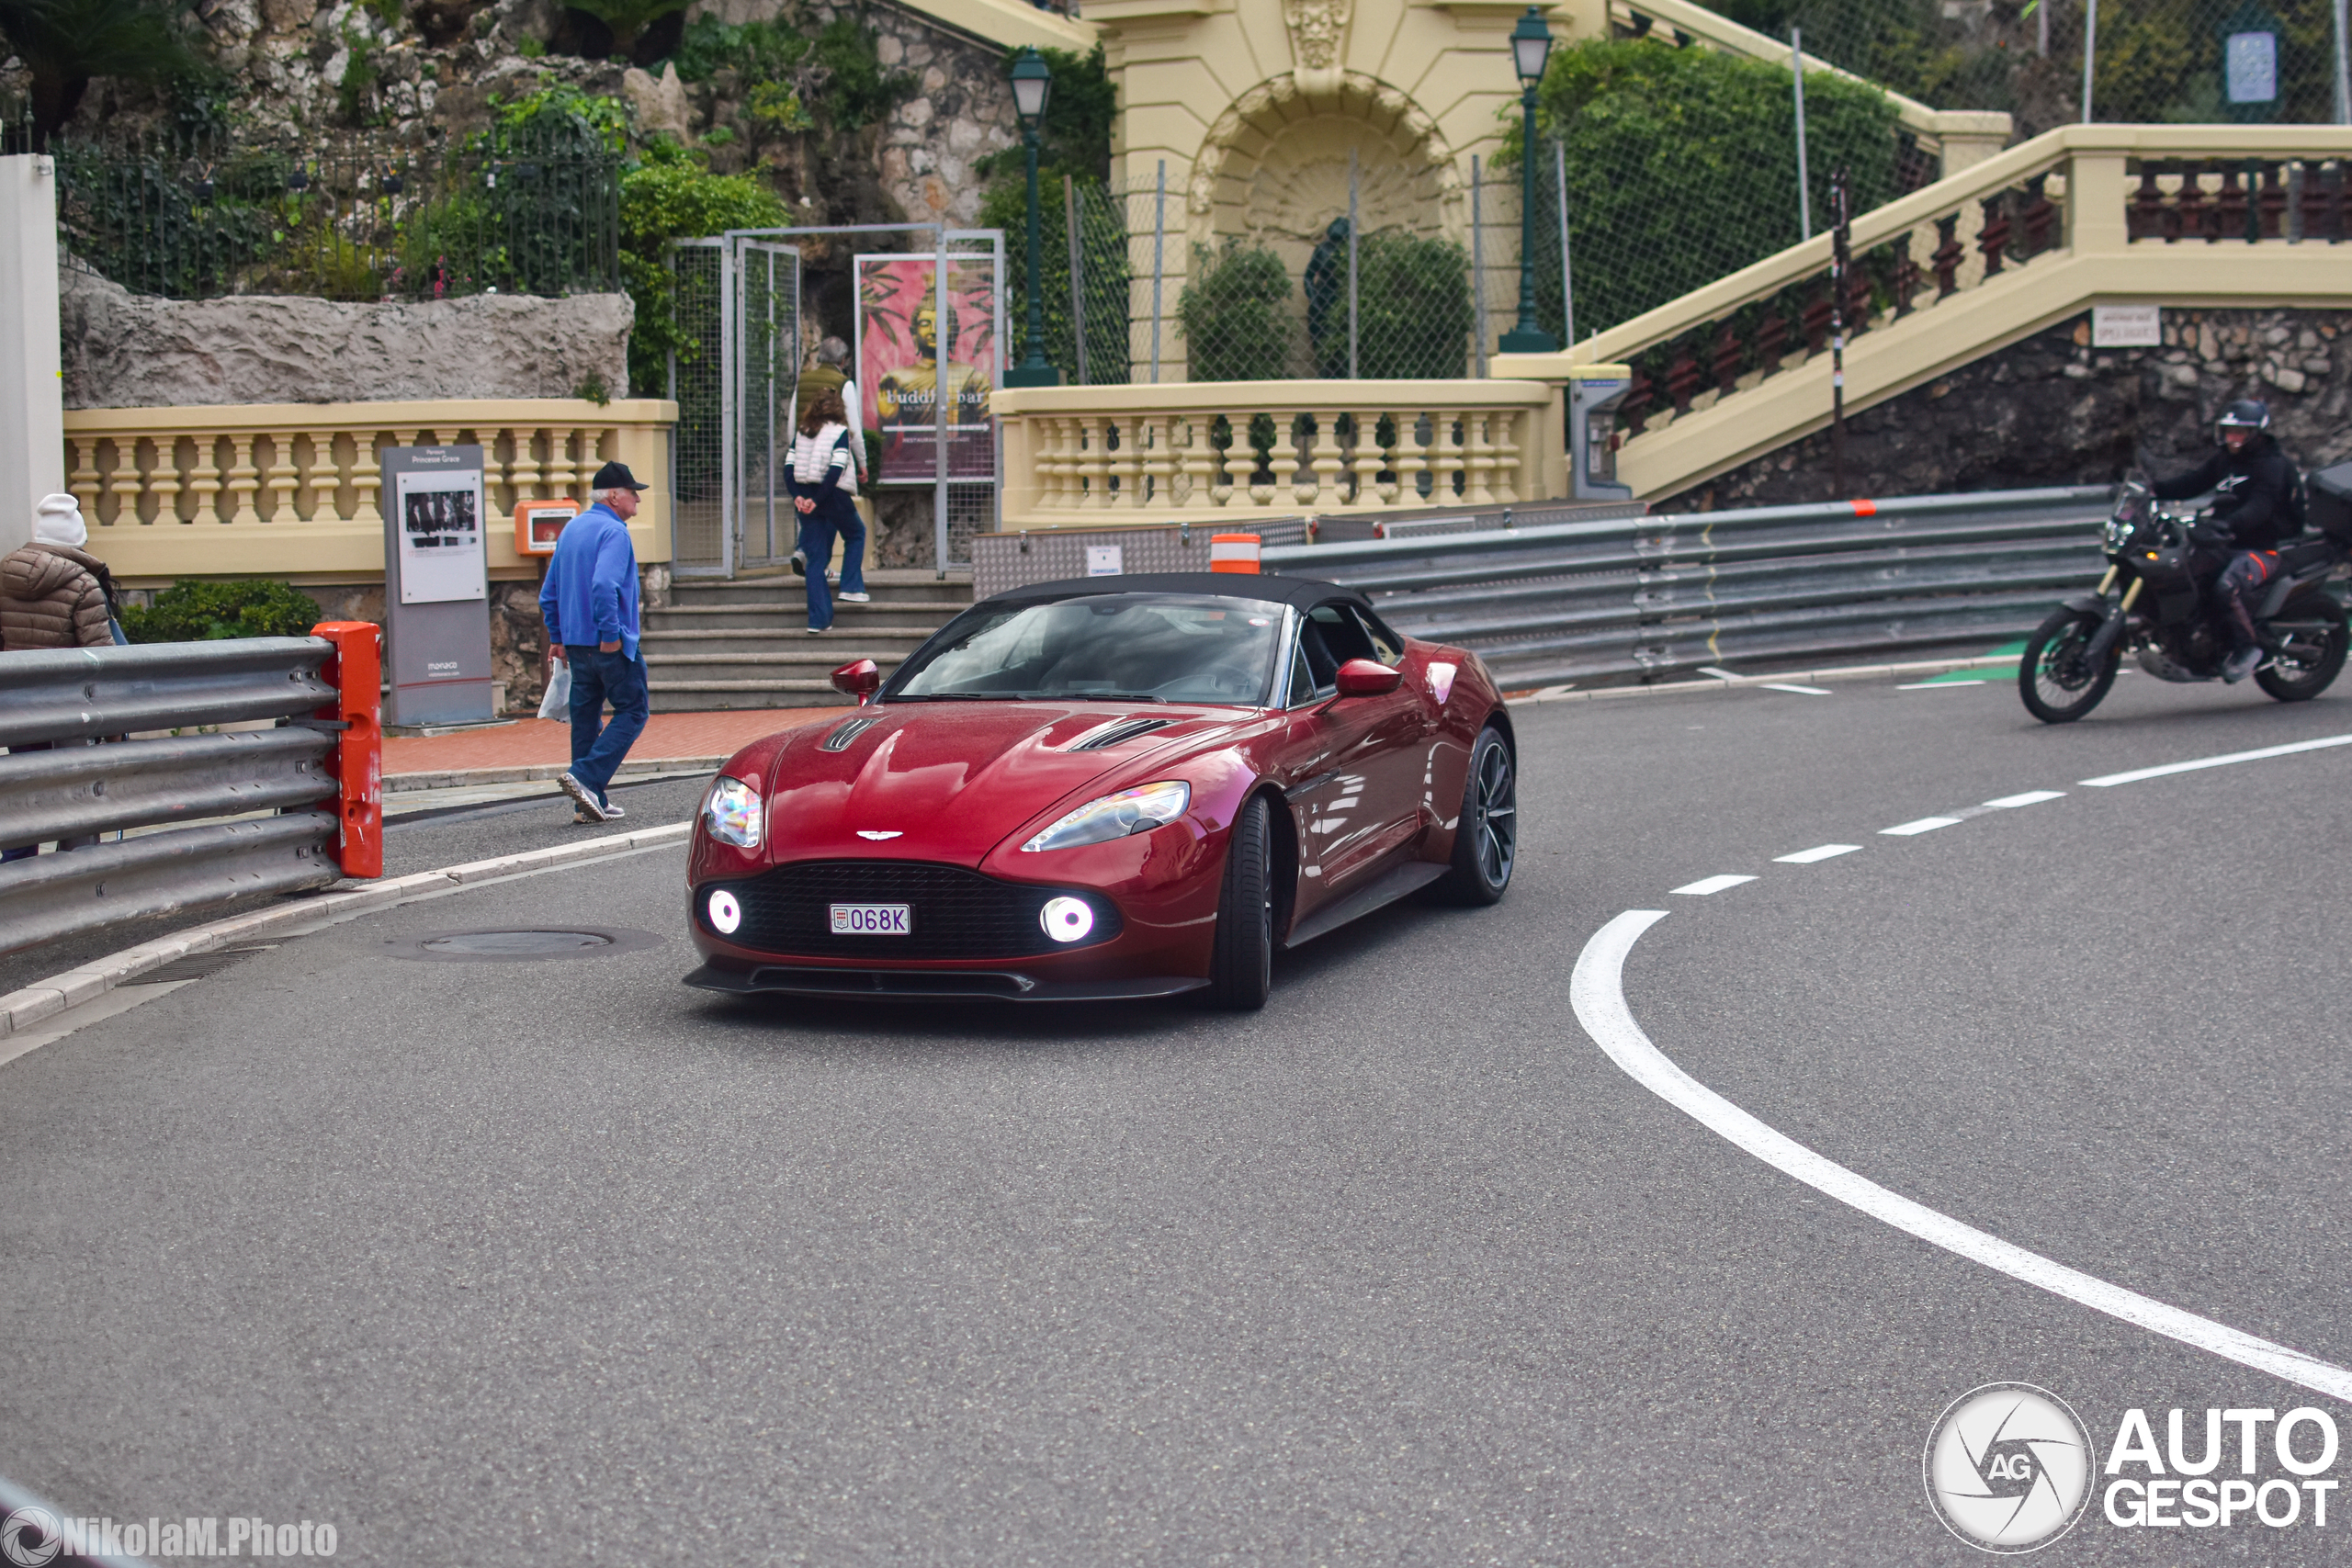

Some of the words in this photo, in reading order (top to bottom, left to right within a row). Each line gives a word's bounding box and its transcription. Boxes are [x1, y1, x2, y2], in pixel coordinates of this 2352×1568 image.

[441, 455, 460, 463] Grace
[427, 661, 458, 670] monaco
[851, 908, 906, 931] 068K
